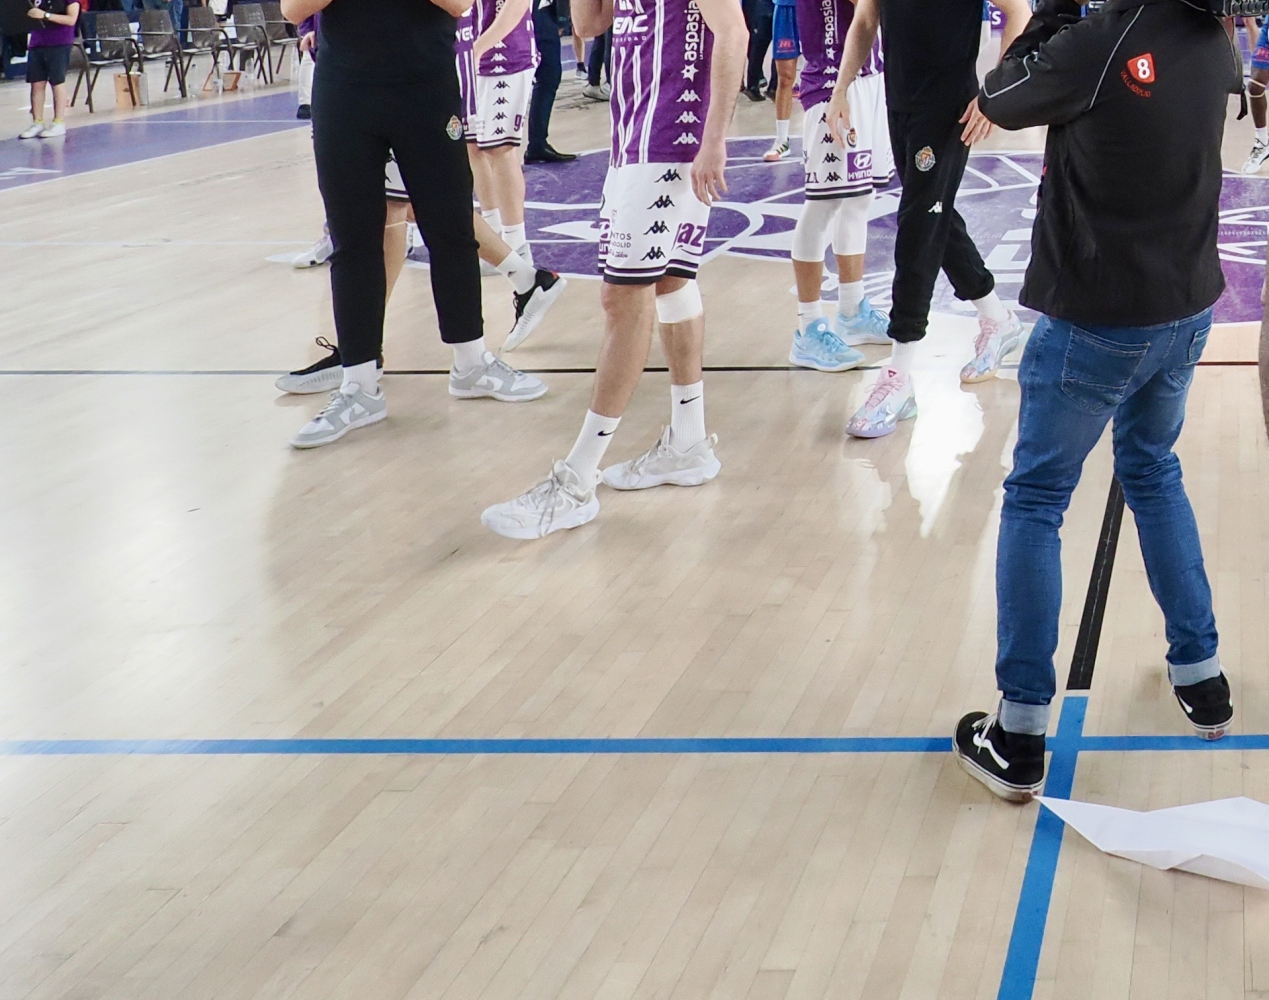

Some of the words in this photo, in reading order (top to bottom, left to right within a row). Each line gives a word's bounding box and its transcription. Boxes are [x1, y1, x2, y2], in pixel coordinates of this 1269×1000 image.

[684, 0, 700, 61] aspasia
[820, 0, 834, 45] aspasia
[1119, 69, 1152, 98] VALLADOLID
[1136, 58, 1151, 80] 8
